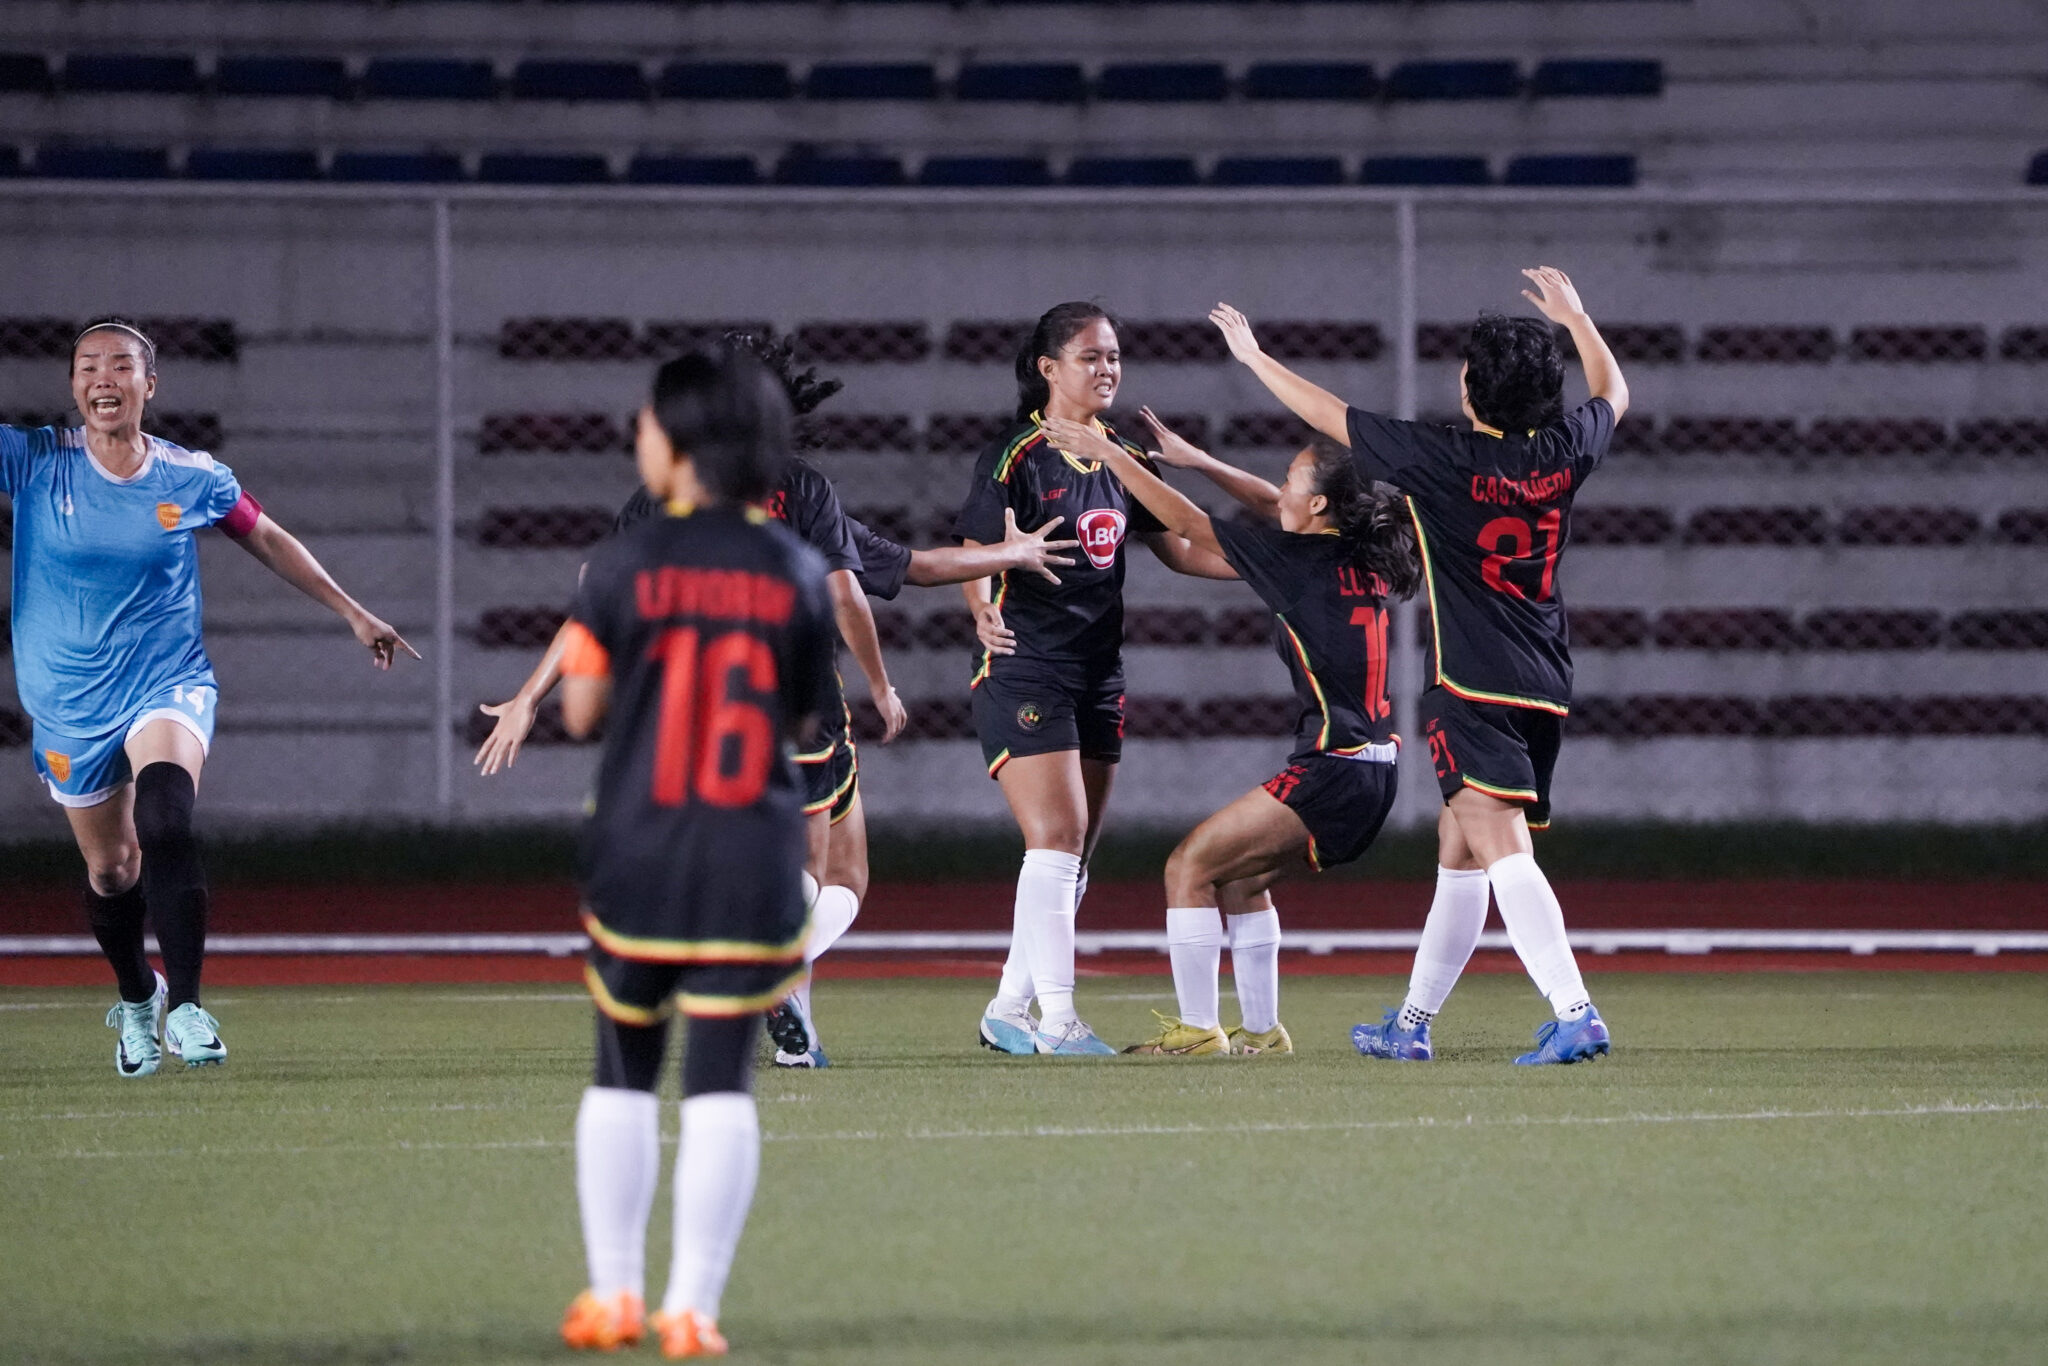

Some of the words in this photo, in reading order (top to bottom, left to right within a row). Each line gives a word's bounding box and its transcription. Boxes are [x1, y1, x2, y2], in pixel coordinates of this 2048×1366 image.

[1087, 526, 1118, 547] LBC
[1476, 507, 1561, 603] 21
[173, 684, 207, 717] 14
[645, 625, 780, 809] 16
[1428, 729, 1458, 779] 21
